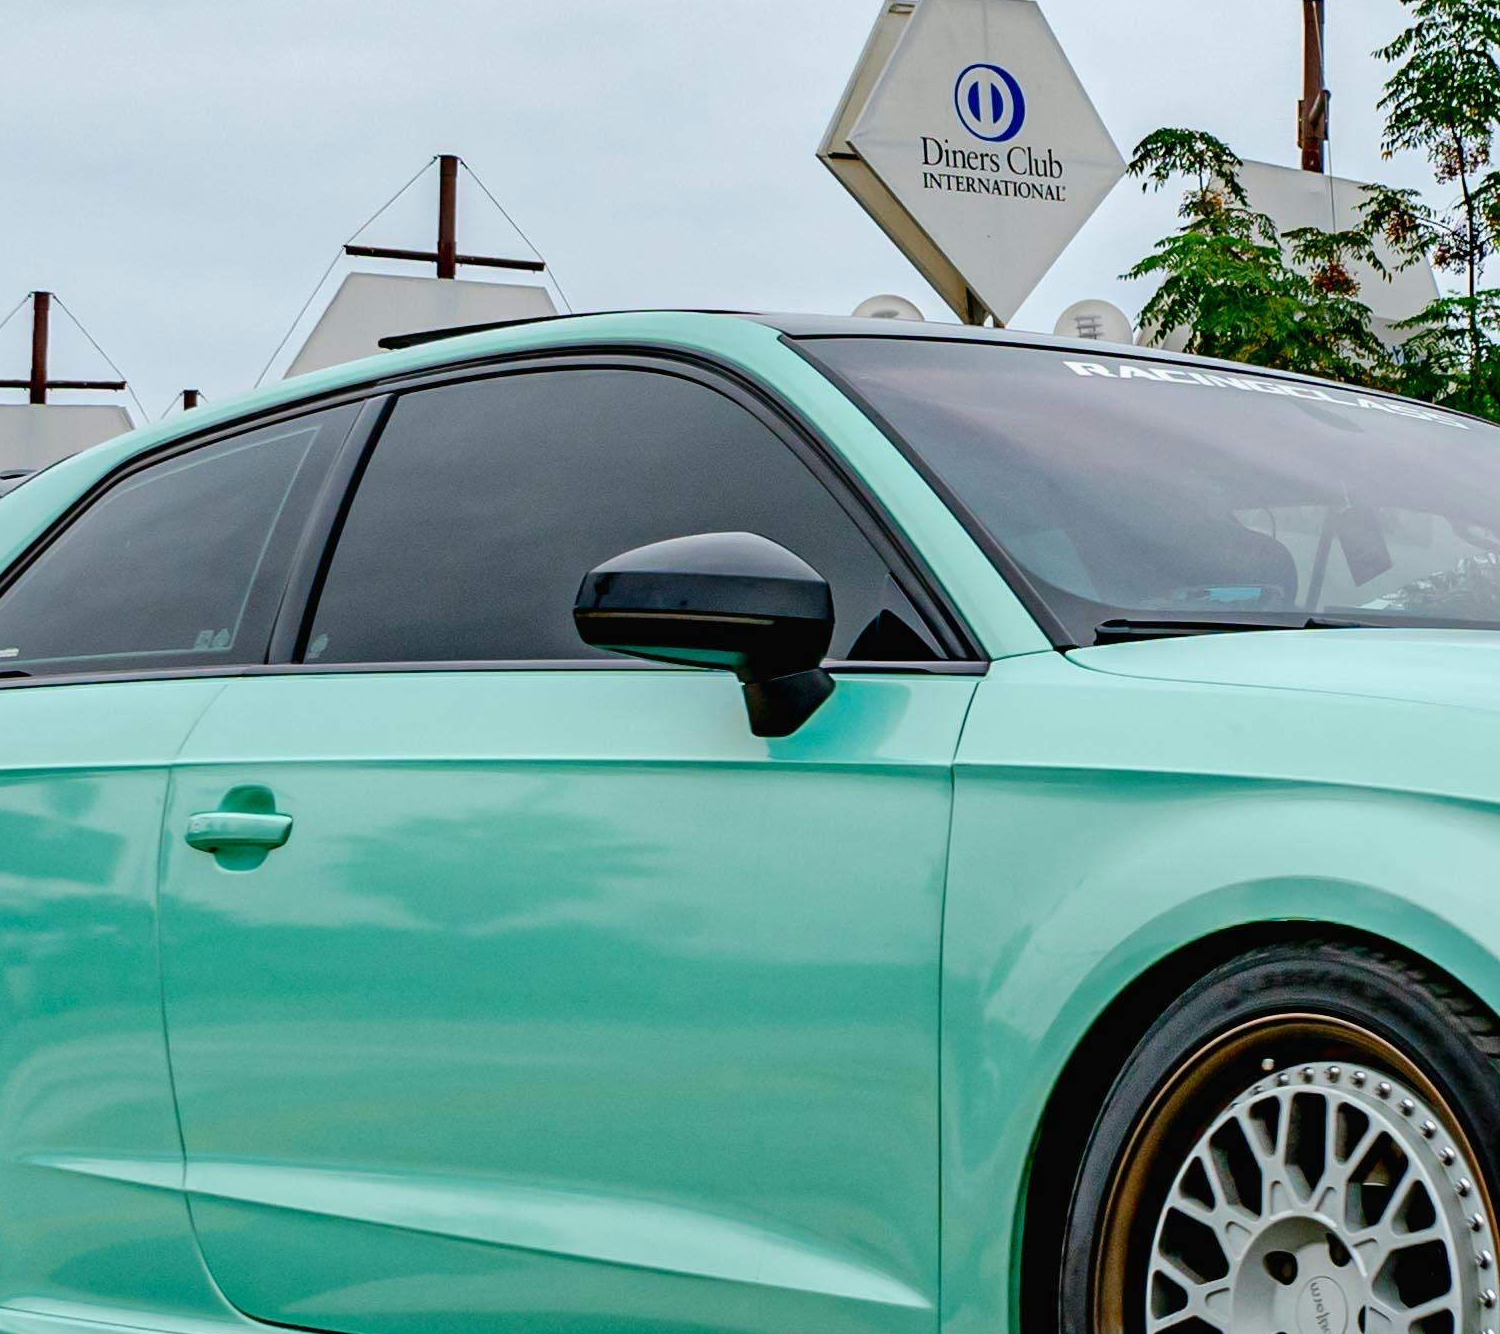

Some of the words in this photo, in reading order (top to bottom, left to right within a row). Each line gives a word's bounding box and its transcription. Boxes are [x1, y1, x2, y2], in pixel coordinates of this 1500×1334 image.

[920, 136, 1000, 174] Diners
[1006, 145, 1063, 179] Club
[1062, 360, 1471, 431] RACINGCLASS
